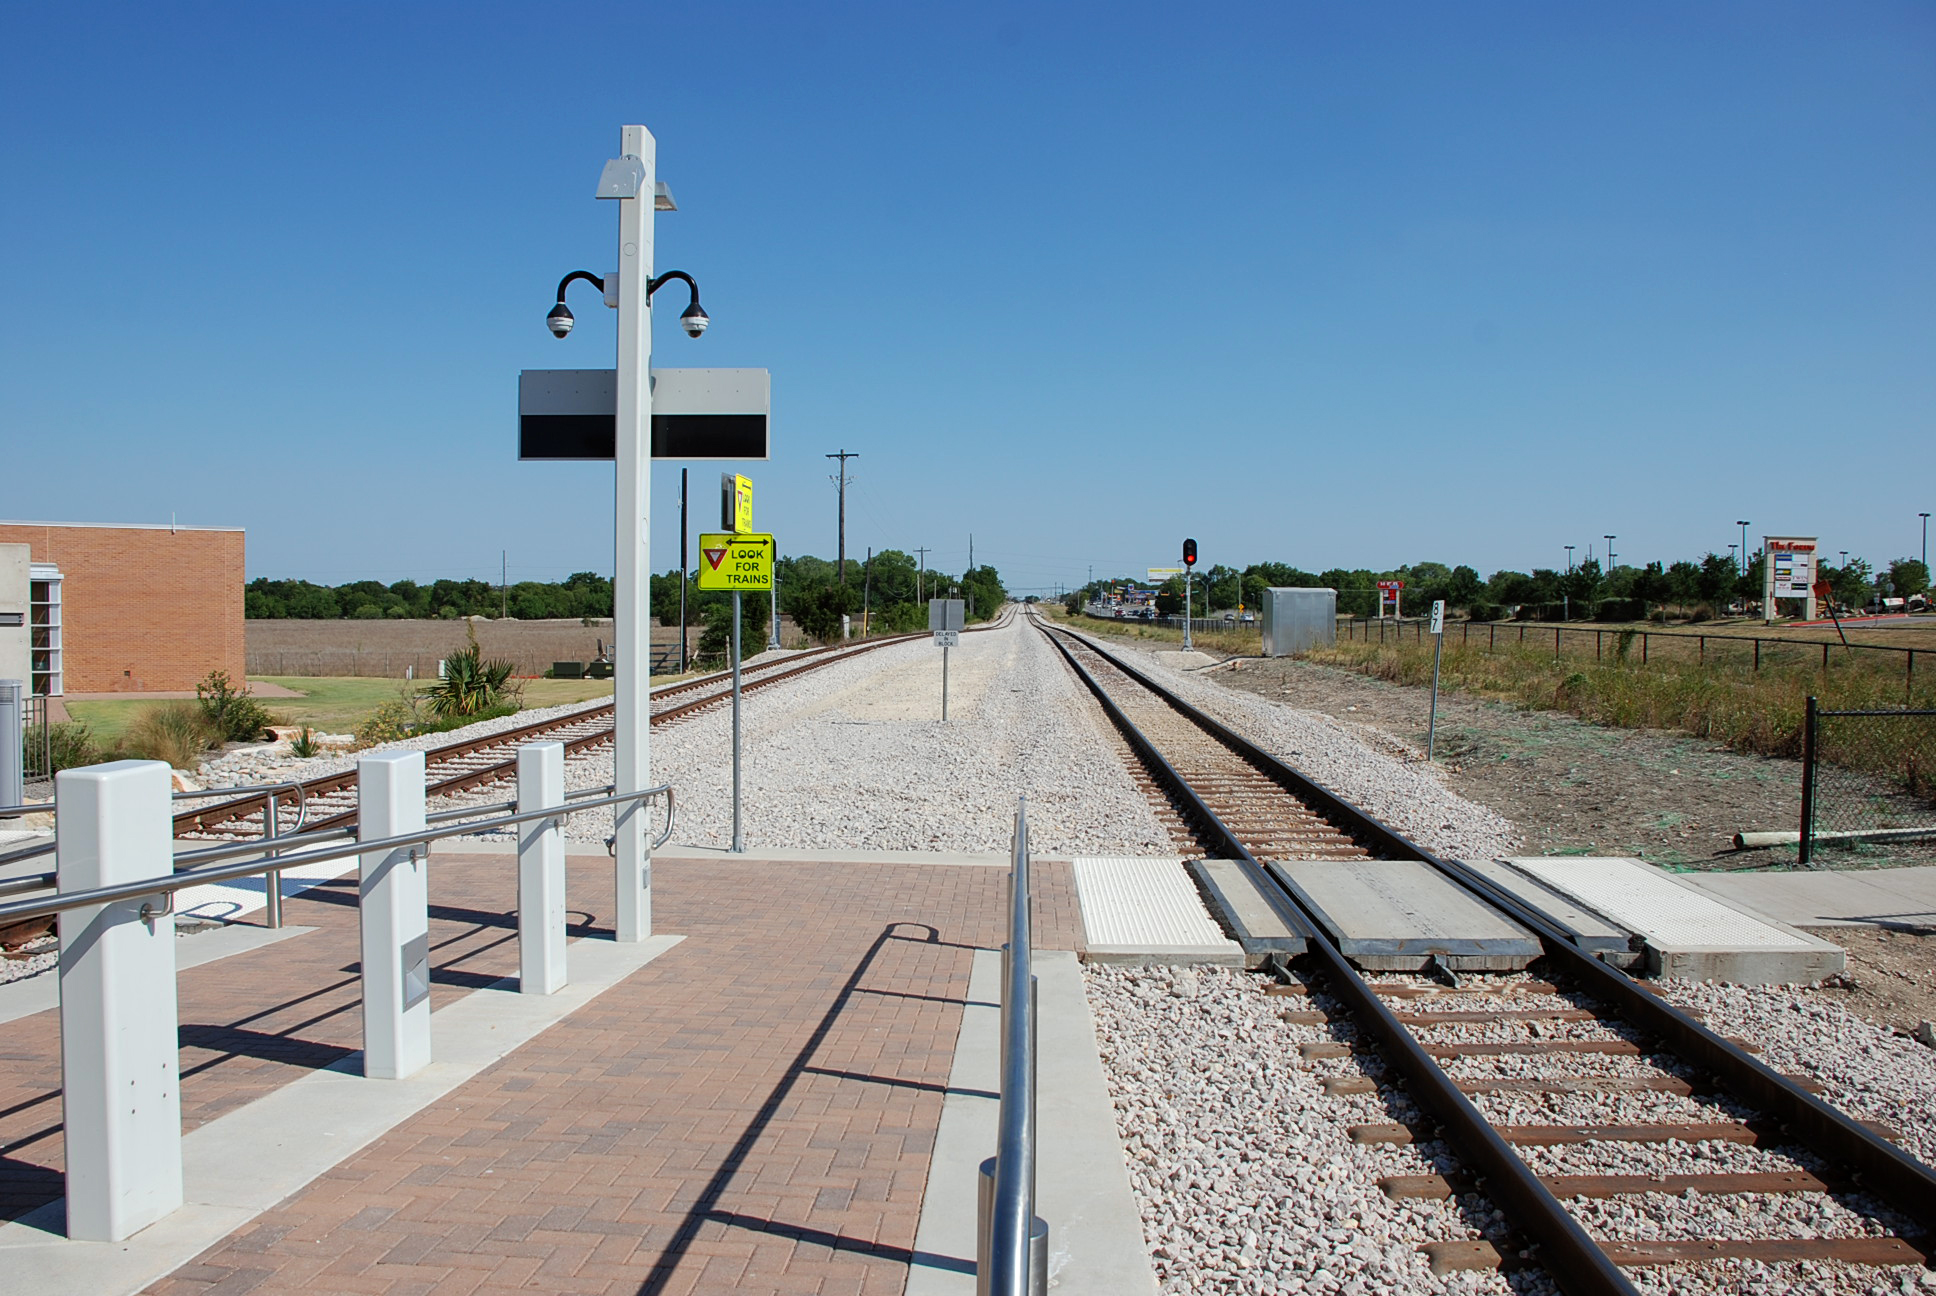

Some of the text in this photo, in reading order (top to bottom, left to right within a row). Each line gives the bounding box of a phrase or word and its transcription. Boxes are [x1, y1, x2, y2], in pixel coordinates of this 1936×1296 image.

[732, 550, 764, 559] LOOK
[736, 562, 760, 571] FOR
[726, 575, 768, 584] TRAINS
